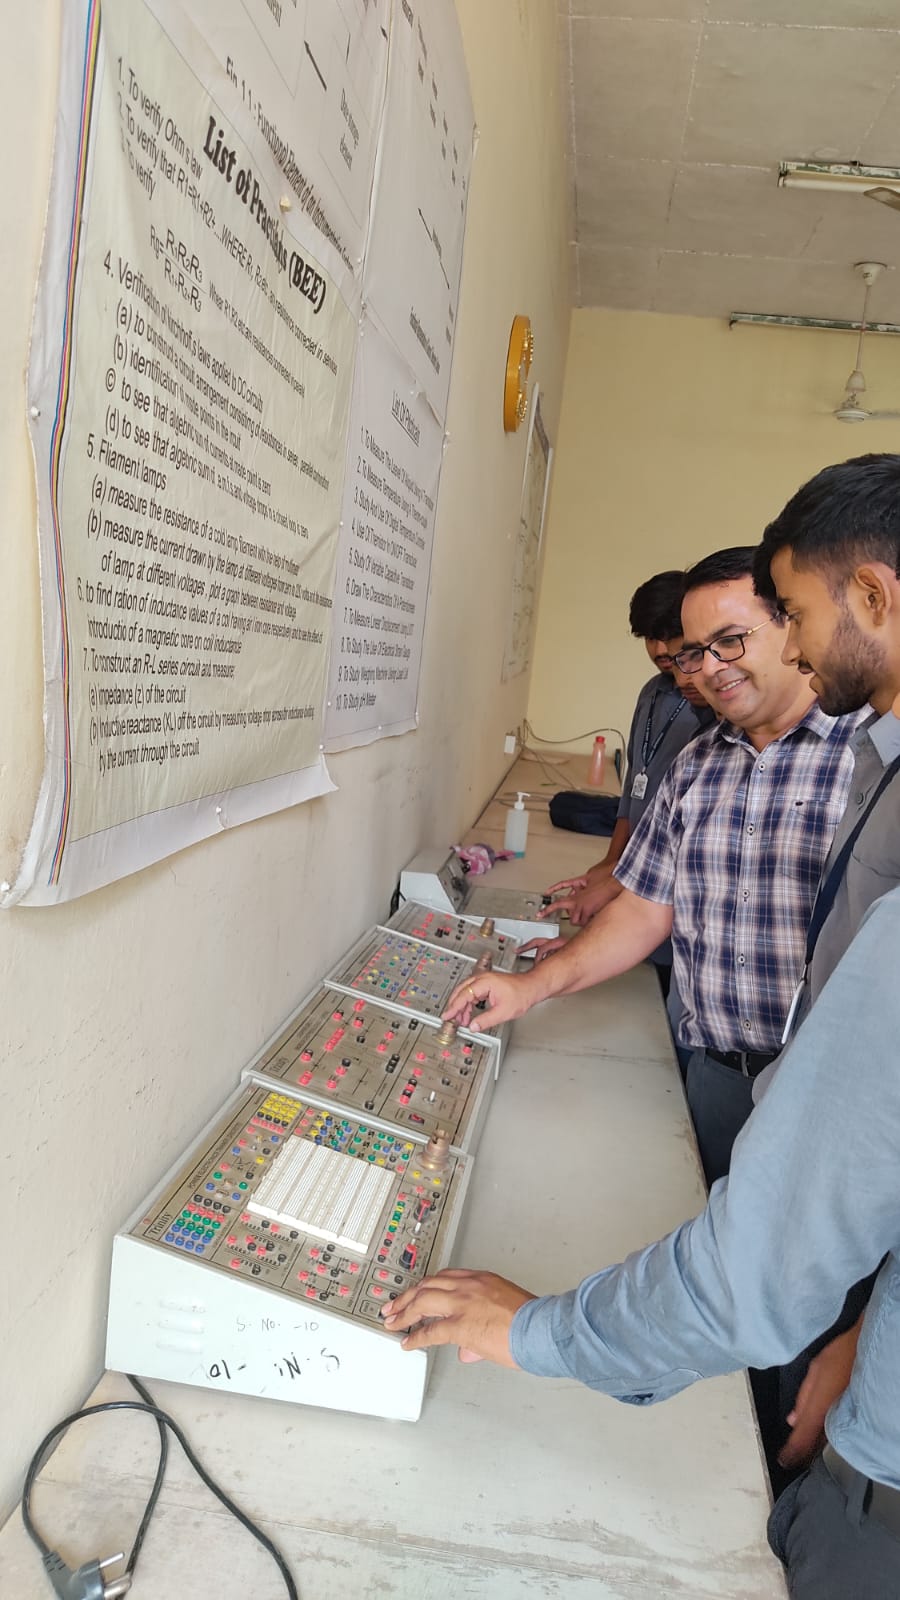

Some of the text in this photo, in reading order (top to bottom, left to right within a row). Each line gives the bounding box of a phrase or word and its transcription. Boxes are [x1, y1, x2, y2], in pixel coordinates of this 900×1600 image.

[118, 56, 125, 86] 1.
[128, 67, 139, 101] To
[141, 89, 164, 136] verify
[191, 149, 203, 181] law
[126, 103, 176, 184] To verify that
[135, 160, 156, 202] verify
[203, 115, 237, 183] List
[235, 168, 252, 204] of
[288, 251, 327, 314] (BEE)
[103, 249, 114, 279] 4.
[118, 256, 160, 317] Verification
[197, 340, 211, 369] laws
[211, 356, 232, 388] applied
[237, 376, 247, 399] DC
[113, 333, 128, 370] (b)
[130, 343, 179, 399] identification
[116, 297, 132, 334] (a)
[133, 309, 145, 336] to
[178, 355, 196, 387] circuit
[196, 373, 229, 415] arrangement
[229, 402, 255, 438] consisting
[121, 376, 132, 402] to
[133, 388, 151, 413] see
[152, 395, 169, 425] that
[105, 405, 120, 440] (d)
[122, 414, 132, 440] to
[133, 425, 151, 449] see
[152, 431, 170, 459] that
[86, 432, 96, 460] 5.
[141, 458, 168, 493] lamps
[370, 434, 385, 464] Measure
[366, 462, 383, 493] Measure
[91, 472, 108, 506] (a)
[107, 485, 148, 516] measure
[149, 498, 162, 521] the
[163, 506, 200, 536] resistance
[200, 520, 209, 539] of
[213, 527, 226, 547] cold
[225, 528, 239, 555] lamp
[358, 489, 371, 517] Study
[87, 507, 239, 582] (b) measure the current drawn by the lamp
[356, 521, 365, 542] Use
[353, 548, 365, 574] Study
[101, 549, 113, 572] of
[112, 551, 135, 583] lamp
[136, 560, 146, 581] at
[146, 562, 177, 590] different
[177, 572, 206, 598] voltages
[208, 580, 222, 603] plot
[226, 587, 241, 607] graph
[240, 590, 259, 609] between
[350, 578, 362, 598] Draw
[362, 582, 370, 601] The
[85, 579, 95, 604] to
[96, 581, 113, 608] find
[114, 588, 138, 612] ration
[138, 592, 150, 614] of
[149, 594, 188, 621] inductance
[188, 603, 209, 624] values
[209, 607, 217, 626] of
[354, 609, 371, 628] Measure
[128, 621, 139, 643] of
[138, 626, 144, 644] a
[145, 626, 180, 650] magnetic
[180, 634, 194, 650] core
[194, 635, 203, 651] on
[351, 638, 363, 658] Study
[83, 647, 90, 673] 7.
[90, 647, 99, 672] To
[99, 651, 132, 674] construct
[132, 656, 142, 674] an
[143, 653, 157, 675] R-L
[157, 655, 179, 676] series
[179, 657, 201, 677] circuit
[200, 658, 212, 677] and
[349, 665, 361, 686] Study
[88, 681, 187, 712] (a) impedance (z) of the circuit
[348, 692, 360, 712] Study
[126, 714, 162, 735] reactance
[162, 711, 177, 736] (XL)
[177, 711, 187, 731] off
[186, 711, 197, 730] the
[197, 710, 215, 729] circuit
[214, 710, 222, 732] by
[222, 708, 247, 729] measuring
[107, 747, 117, 770] the
[117, 743, 140, 768] current
[140, 741, 169, 766] through
[169, 739, 181, 759] the
[181, 736, 200, 758] circuit
[148, 1213, 173, 1237] Trinity
[261, 1318, 281, 1332] No.
